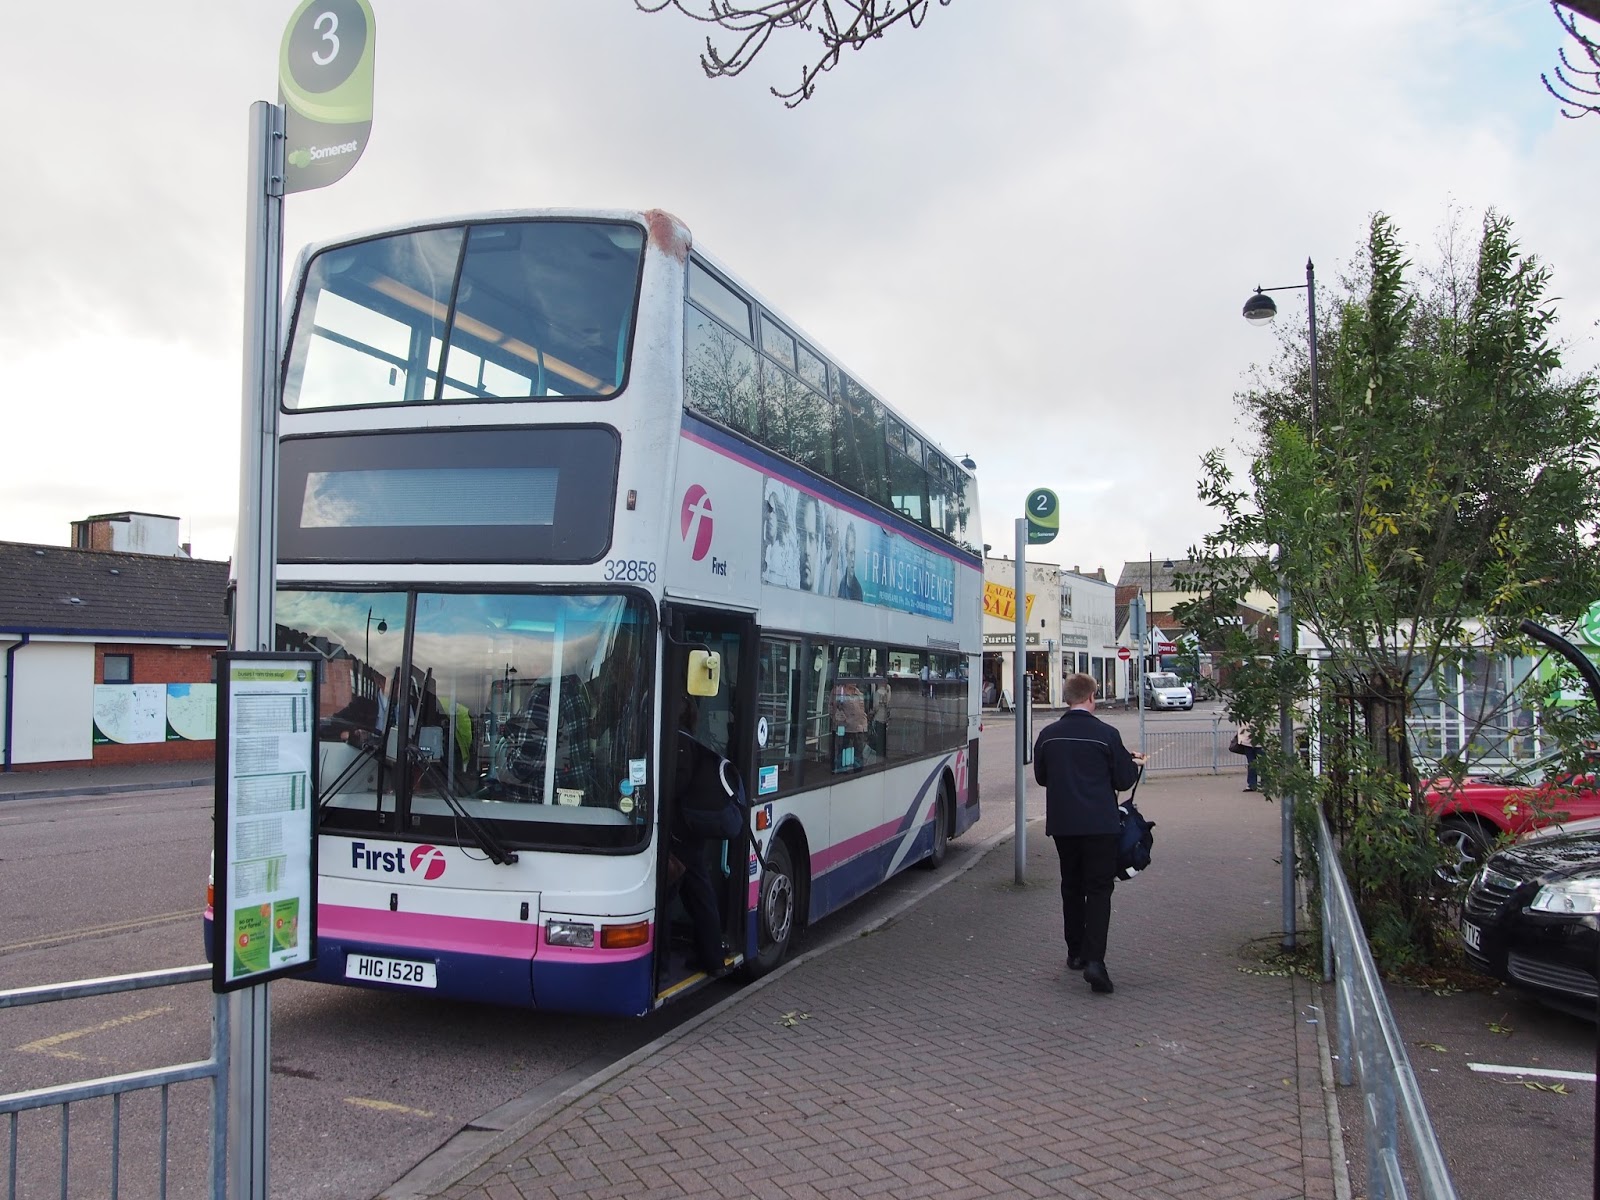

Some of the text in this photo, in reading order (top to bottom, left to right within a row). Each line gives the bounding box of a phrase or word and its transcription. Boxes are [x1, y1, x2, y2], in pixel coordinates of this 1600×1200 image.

[311, 11, 340, 66] 3
[310, 139, 358, 160] Somerset
[1036, 494, 1048, 511] 2
[603, 559, 657, 583] 32858
[712, 556, 727, 577] First
[864, 549, 953, 606] TRANSCENDENCE
[983, 635, 1035, 644] Furnitre
[352, 841, 405, 874] First
[359, 957, 424, 983] HIG 1528
